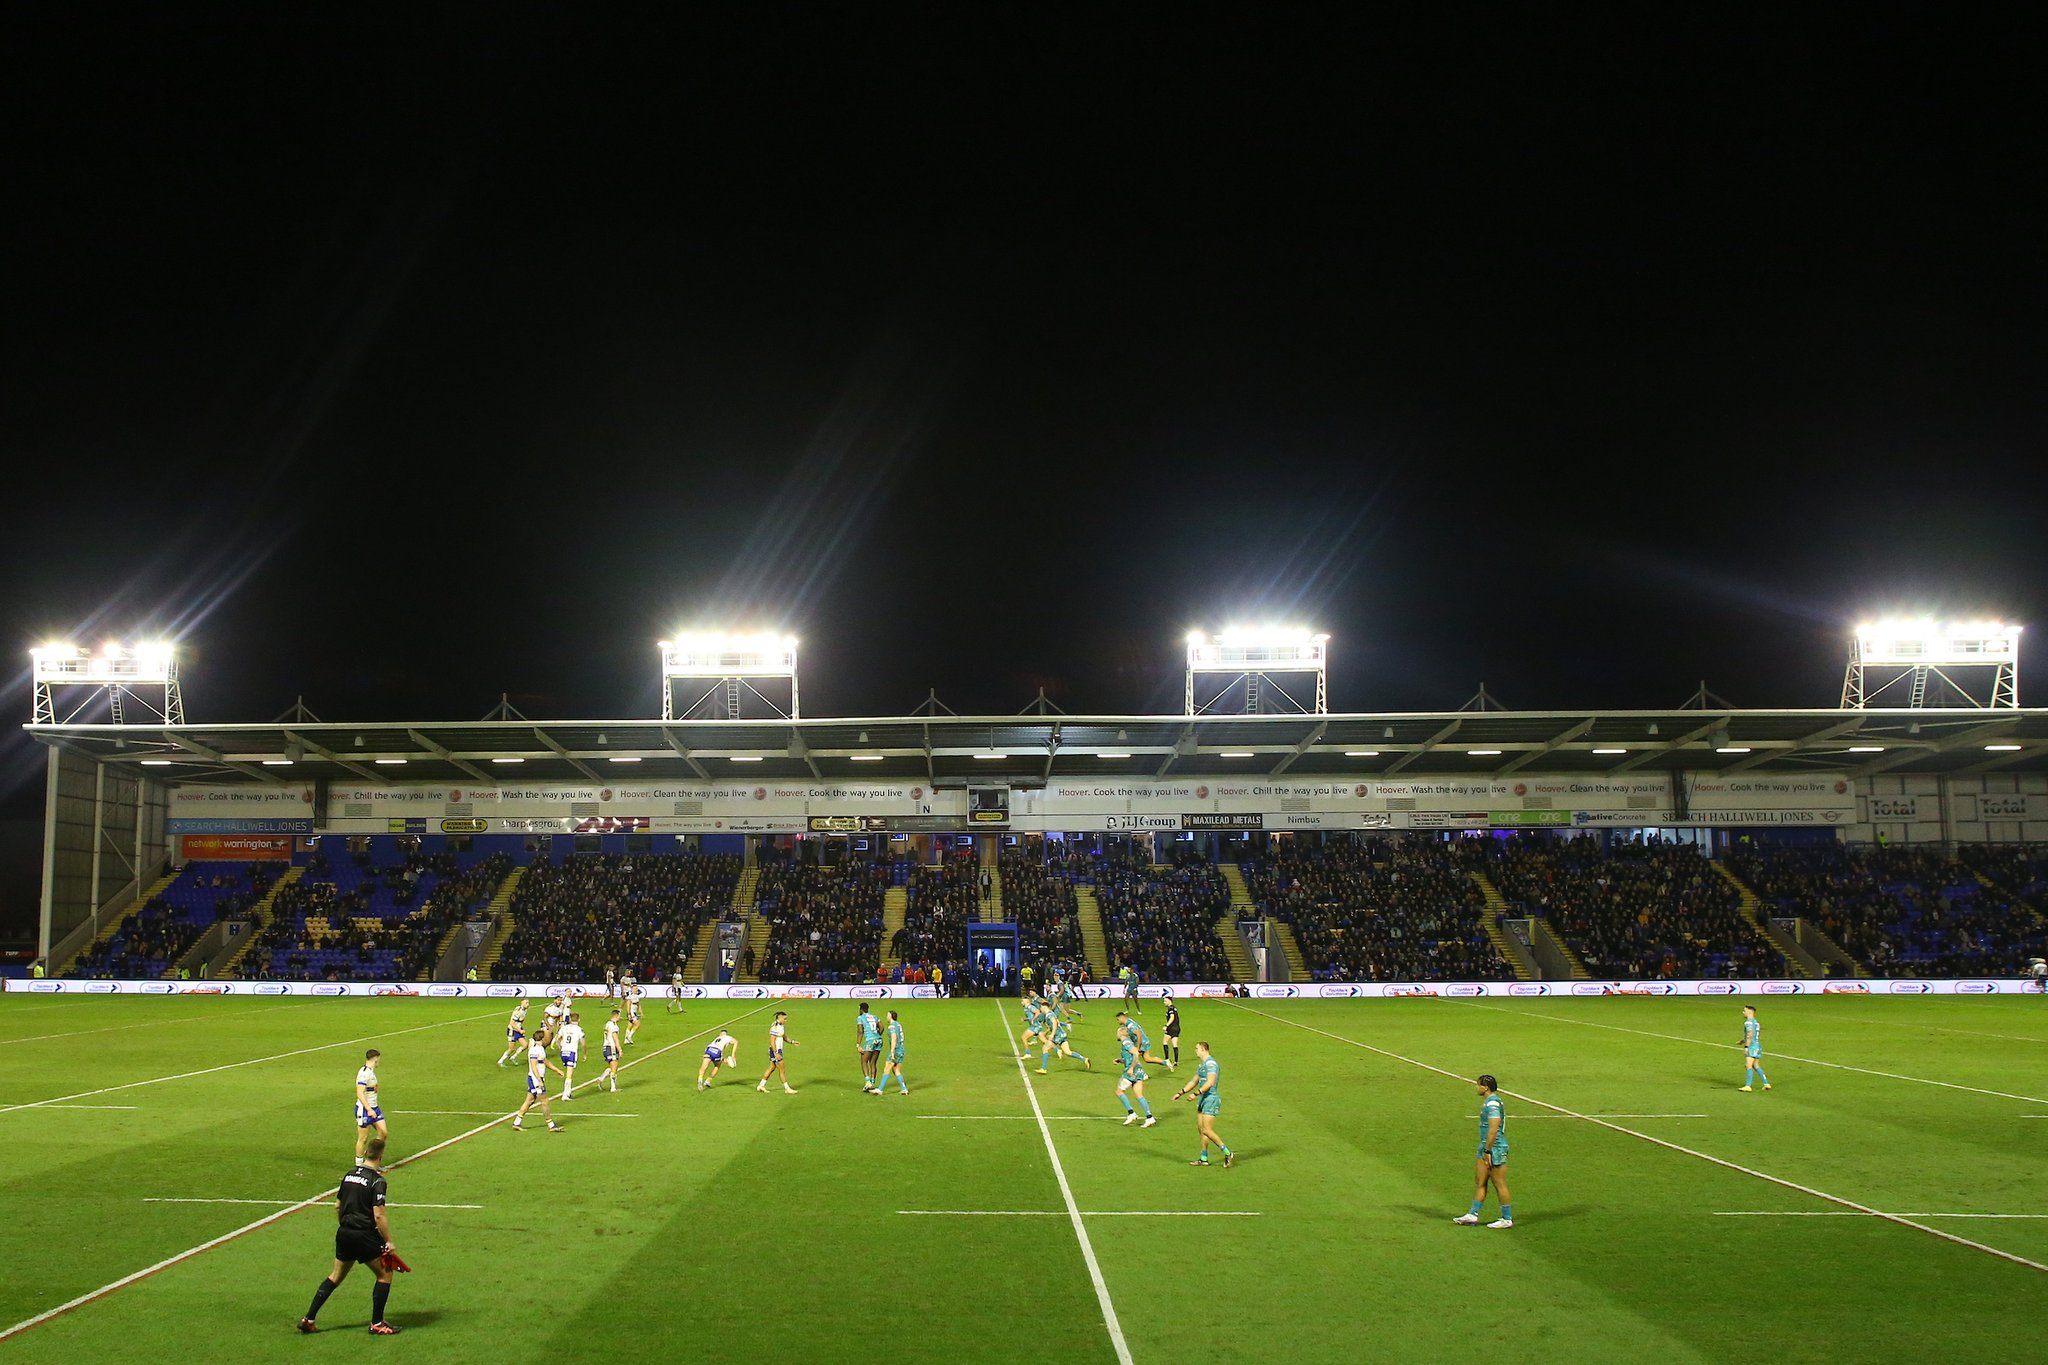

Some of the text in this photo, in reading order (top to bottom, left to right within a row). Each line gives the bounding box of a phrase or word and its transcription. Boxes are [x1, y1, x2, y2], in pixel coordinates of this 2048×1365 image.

[1253, 787, 1272, 795] Chill
[1275, 787, 1289, 795] the
[1491, 785, 1506, 793] live
[1612, 786, 1629, 794] way
[1650, 784, 1664, 792] live
[1755, 783, 1769, 791] the
[1810, 783, 1825, 791] live
[355, 792, 372, 800] Chill
[390, 793, 406, 801] way
[409, 793, 424, 801] you
[502, 791, 523, 799] Wash
[525, 791, 539, 799] the
[560, 792, 576, 800] you
[653, 790, 676, 798] Clean
[809, 789, 830, 797] Cook
[833, 789, 847, 797] the
[869, 791, 885, 799] you
[888, 789, 902, 797] live
[1174, 788, 1189, 796] live
[246, 794, 262, 802] way
[265, 794, 279, 802] you
[1871, 799, 1916, 815] Total
[1980, 798, 2026, 814] Total
[1193, 816, 1261, 825] MAXILEAD METALS
[1288, 816, 1320, 824] Nimbus
[1709, 813, 1777, 822] HALLIWELL
[1780, 812, 1814, 823] JONES
[224, 822, 274, 831] HALLIWELL
[276, 822, 307, 832] JONES
[224, 839, 272, 850] warrington
[566, 1036, 572, 1044] 9
